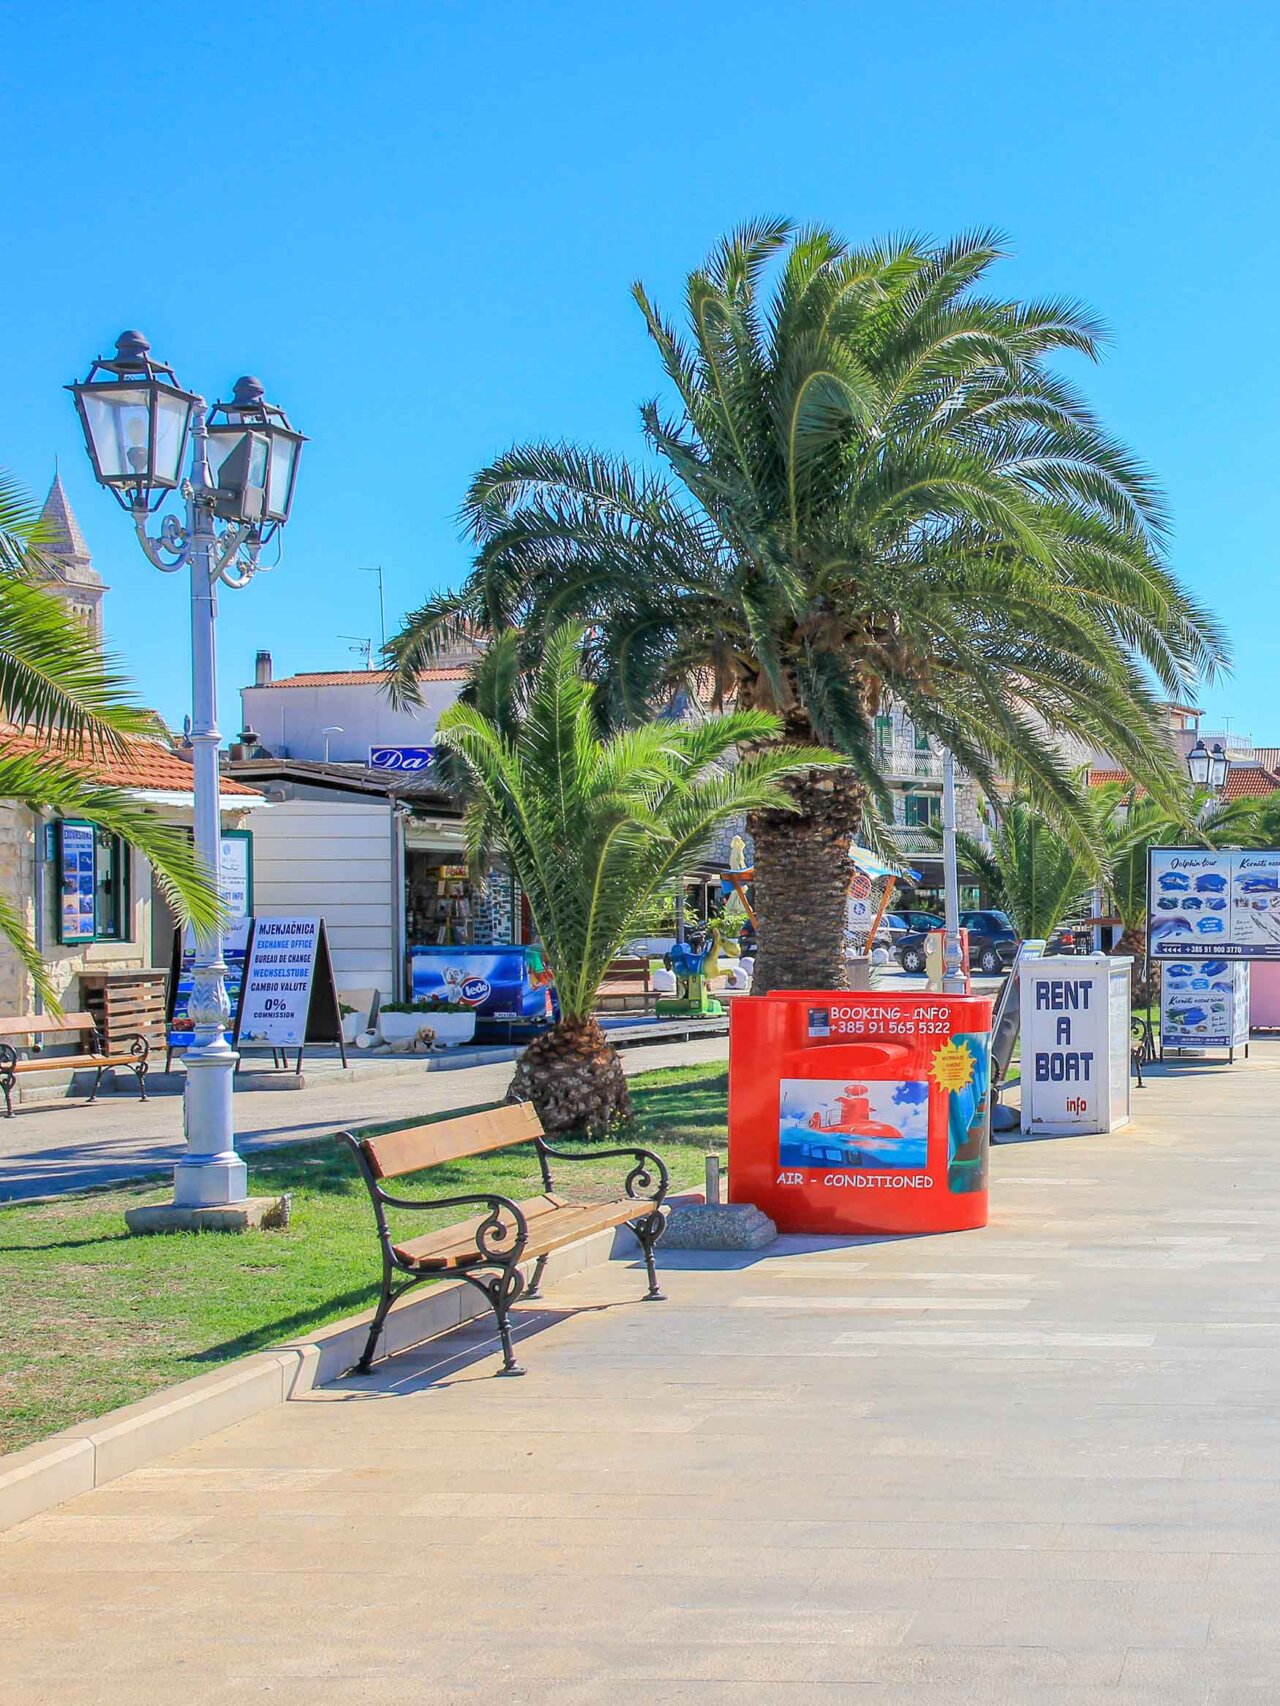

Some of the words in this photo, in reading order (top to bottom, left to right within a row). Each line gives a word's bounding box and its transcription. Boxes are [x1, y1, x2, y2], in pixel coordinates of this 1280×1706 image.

[1171, 858, 1200, 869] Dolphin
[1201, 858, 1217, 868] tour
[1239, 858, 1267, 869] Kornati
[259, 921, 315, 935] MJENJAČNICA
[257, 940, 289, 949] EXCHANGE
[290, 940, 313, 949] OFFICE
[1226, 946, 1242, 954] 3770
[254, 954, 278, 963] BUREAU
[279, 954, 286, 963] DE
[288, 954, 311, 963] CHANGE
[253, 968, 309, 978] WECHSELSTUBE
[250, 983, 278, 992] CAMBIO
[280, 982, 307, 991] VALUTE
[1036, 981, 1092, 1010] RENT
[264, 998, 286, 1011] 0%
[831, 1007, 901, 1020] BOOKING
[912, 1008, 949, 1020] INFO
[830, 1021, 865, 1034] +385
[869, 1022, 885, 1034] 91
[888, 1022, 915, 1034] 565
[918, 1022, 950, 1034] 5322
[1056, 1016, 1071, 1045] A
[1035, 1052, 1093, 1082] BOAT
[1066, 1097, 1087, 1116] info
[776, 1172, 804, 1185] AIR
[824, 1174, 933, 1188] CONDITIONED
